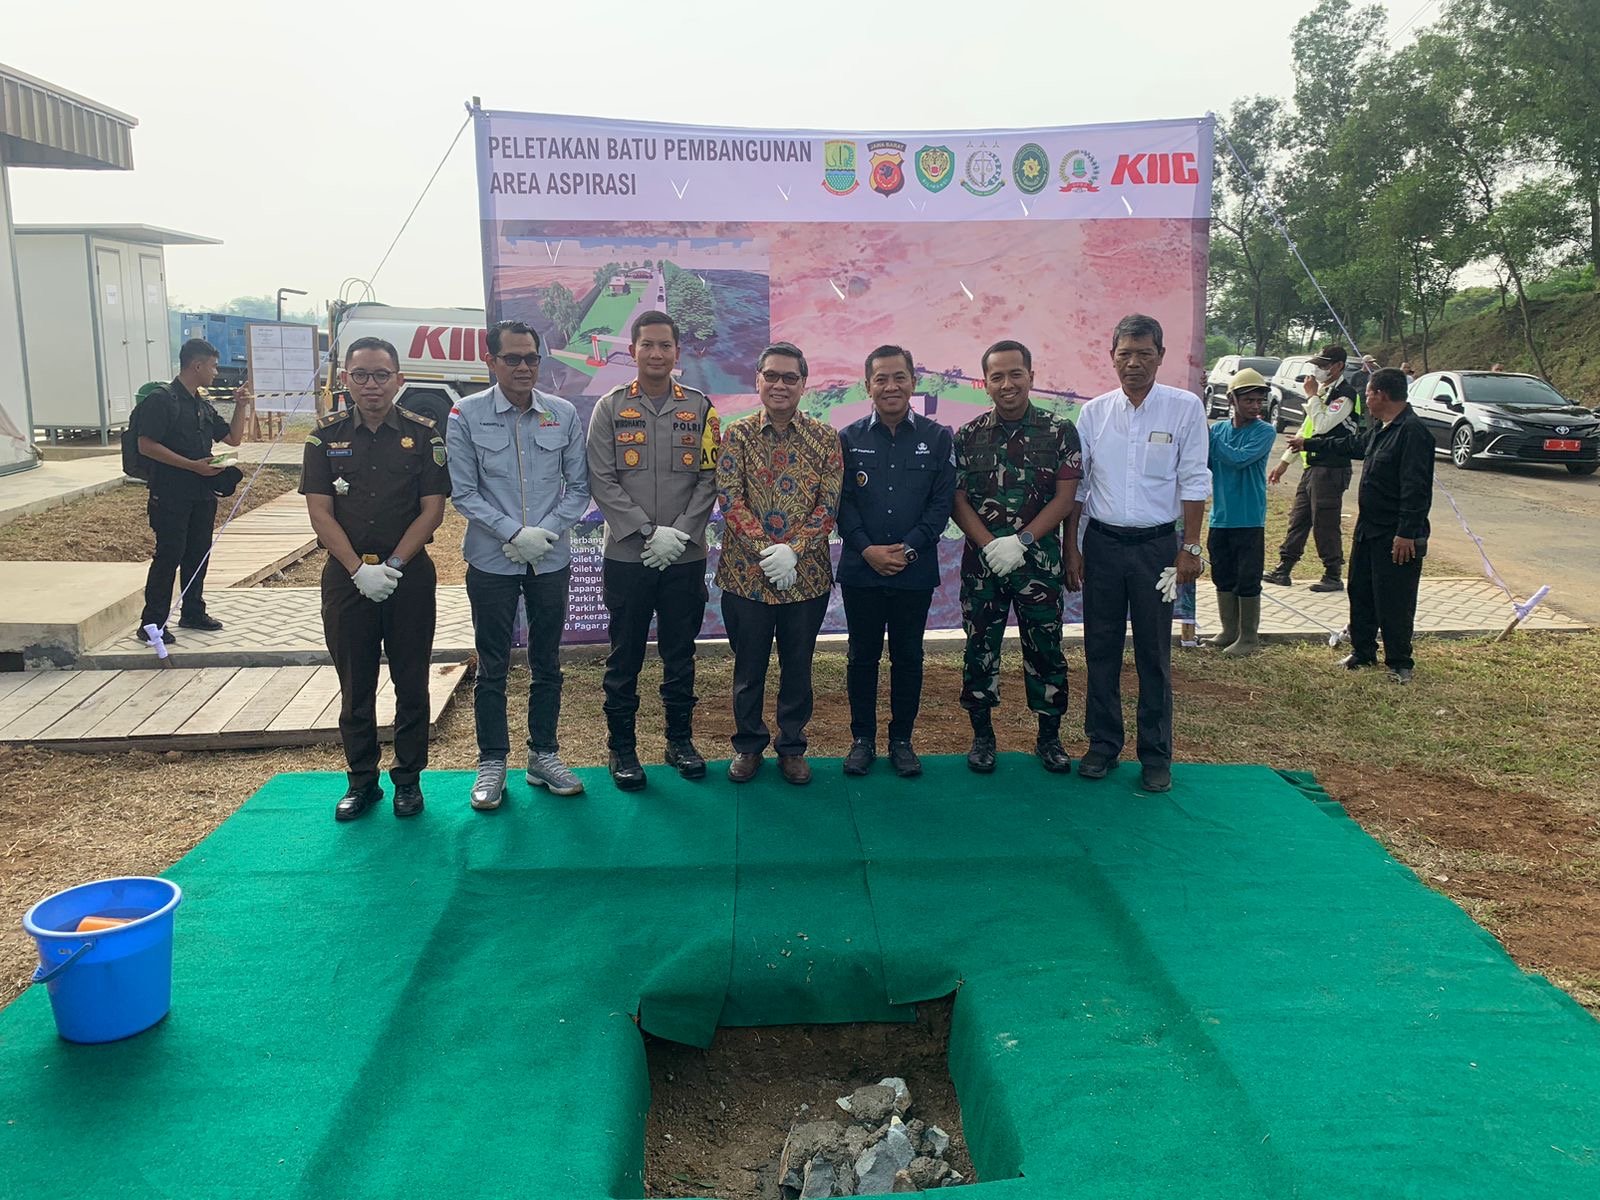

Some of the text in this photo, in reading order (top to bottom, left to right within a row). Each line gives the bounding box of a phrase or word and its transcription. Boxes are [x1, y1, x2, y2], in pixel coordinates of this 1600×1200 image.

[488, 136, 812, 163] PELETAKAN BATU PEMBANGUNAN
[1111, 152, 1199, 185] KIIC
[490, 172, 637, 196] AREA ASPIRASI
[673, 422, 702, 432] POLRI
[569, 604, 596, 612] Parkir
[574, 622, 600, 631] Pagar
